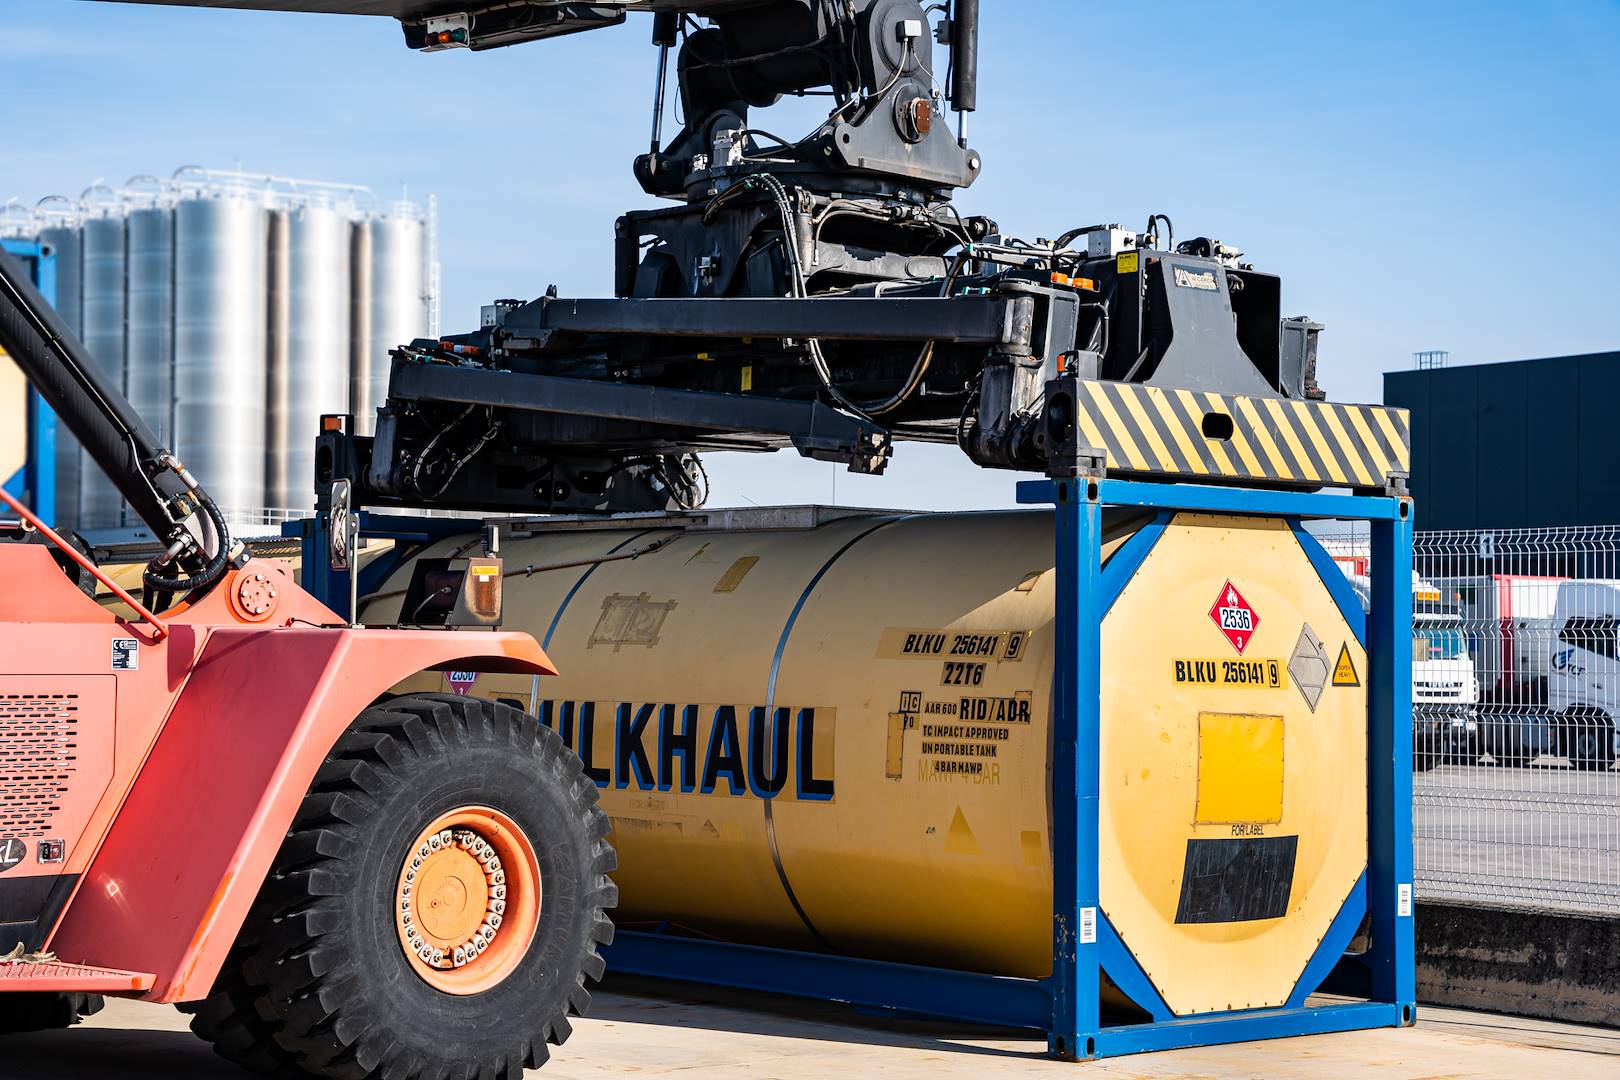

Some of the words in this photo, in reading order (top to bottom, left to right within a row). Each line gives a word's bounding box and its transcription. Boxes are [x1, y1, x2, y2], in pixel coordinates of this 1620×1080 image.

[1222, 609, 1250, 630] 2536
[903, 634, 946, 654] BLKU
[950, 635, 998, 655] 256141
[1006, 635, 1021, 656] 9
[1236, 636, 1243, 649] 3
[944, 663, 983, 685] 22T6
[1175, 660, 1217, 683] BLKU
[1222, 661, 1264, 684] 256141
[1269, 662, 1279, 686] 9
[925, 702, 940, 714] AAR
[942, 703, 957, 715] 600
[922, 725, 933, 737] TC
[934, 726, 964, 738] IMPACT
[965, 727, 1009, 740] APPROVED
[922, 742, 933, 754] UN
[934, 743, 974, 756] PORTABLE
[975, 744, 997, 757] TANK
[1231, 824, 1245, 836] FOR
[1245, 824, 1264, 836] LABEL
